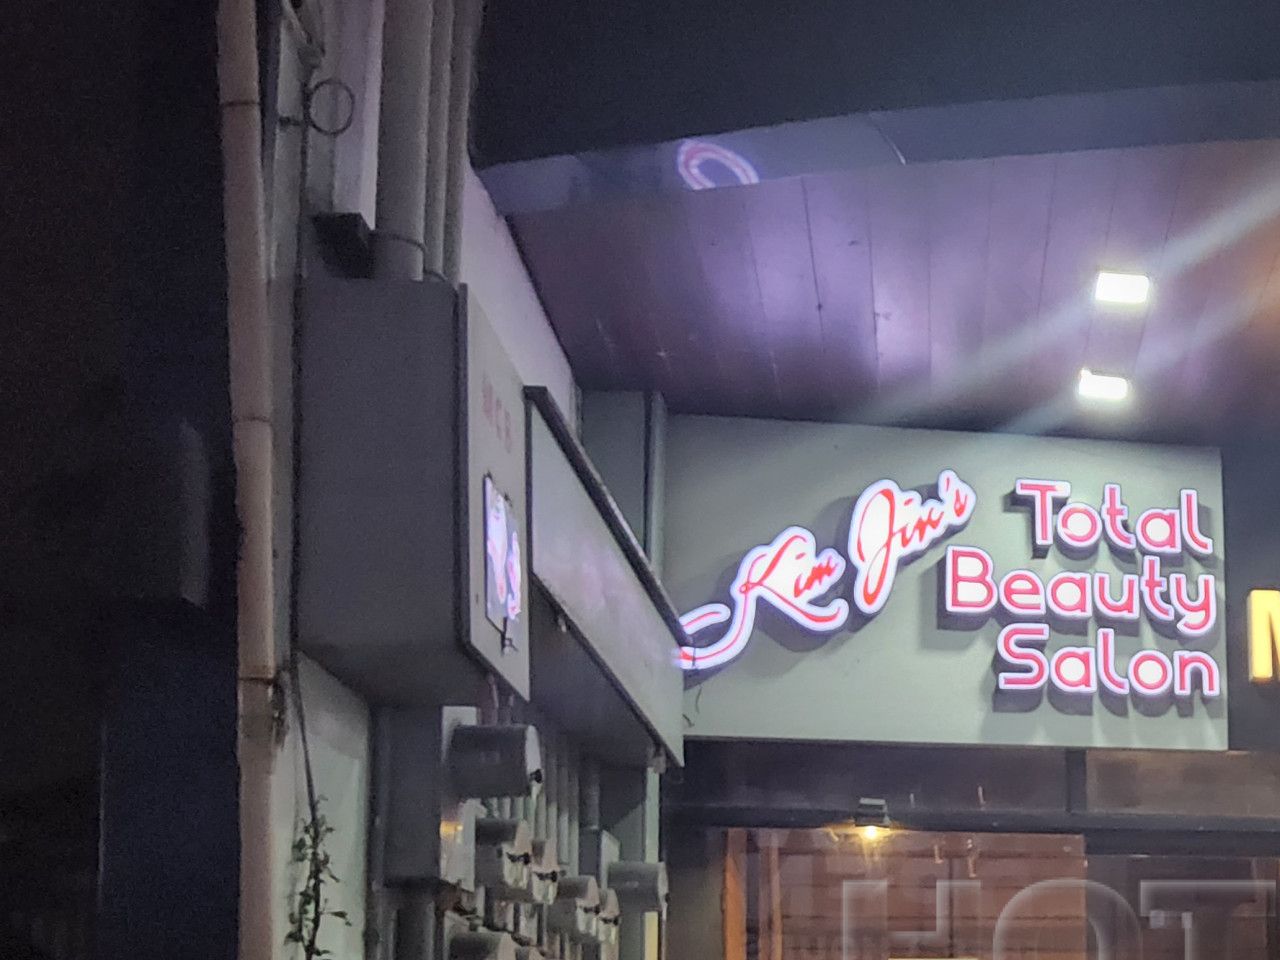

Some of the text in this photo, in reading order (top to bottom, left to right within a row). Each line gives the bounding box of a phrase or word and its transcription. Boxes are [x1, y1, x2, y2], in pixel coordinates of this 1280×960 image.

[1015, 478, 1213, 554] Total
[679, 526, 849, 669] Kim
[945, 545, 1216, 634] Beauty
[997, 623, 1220, 696] Salon
